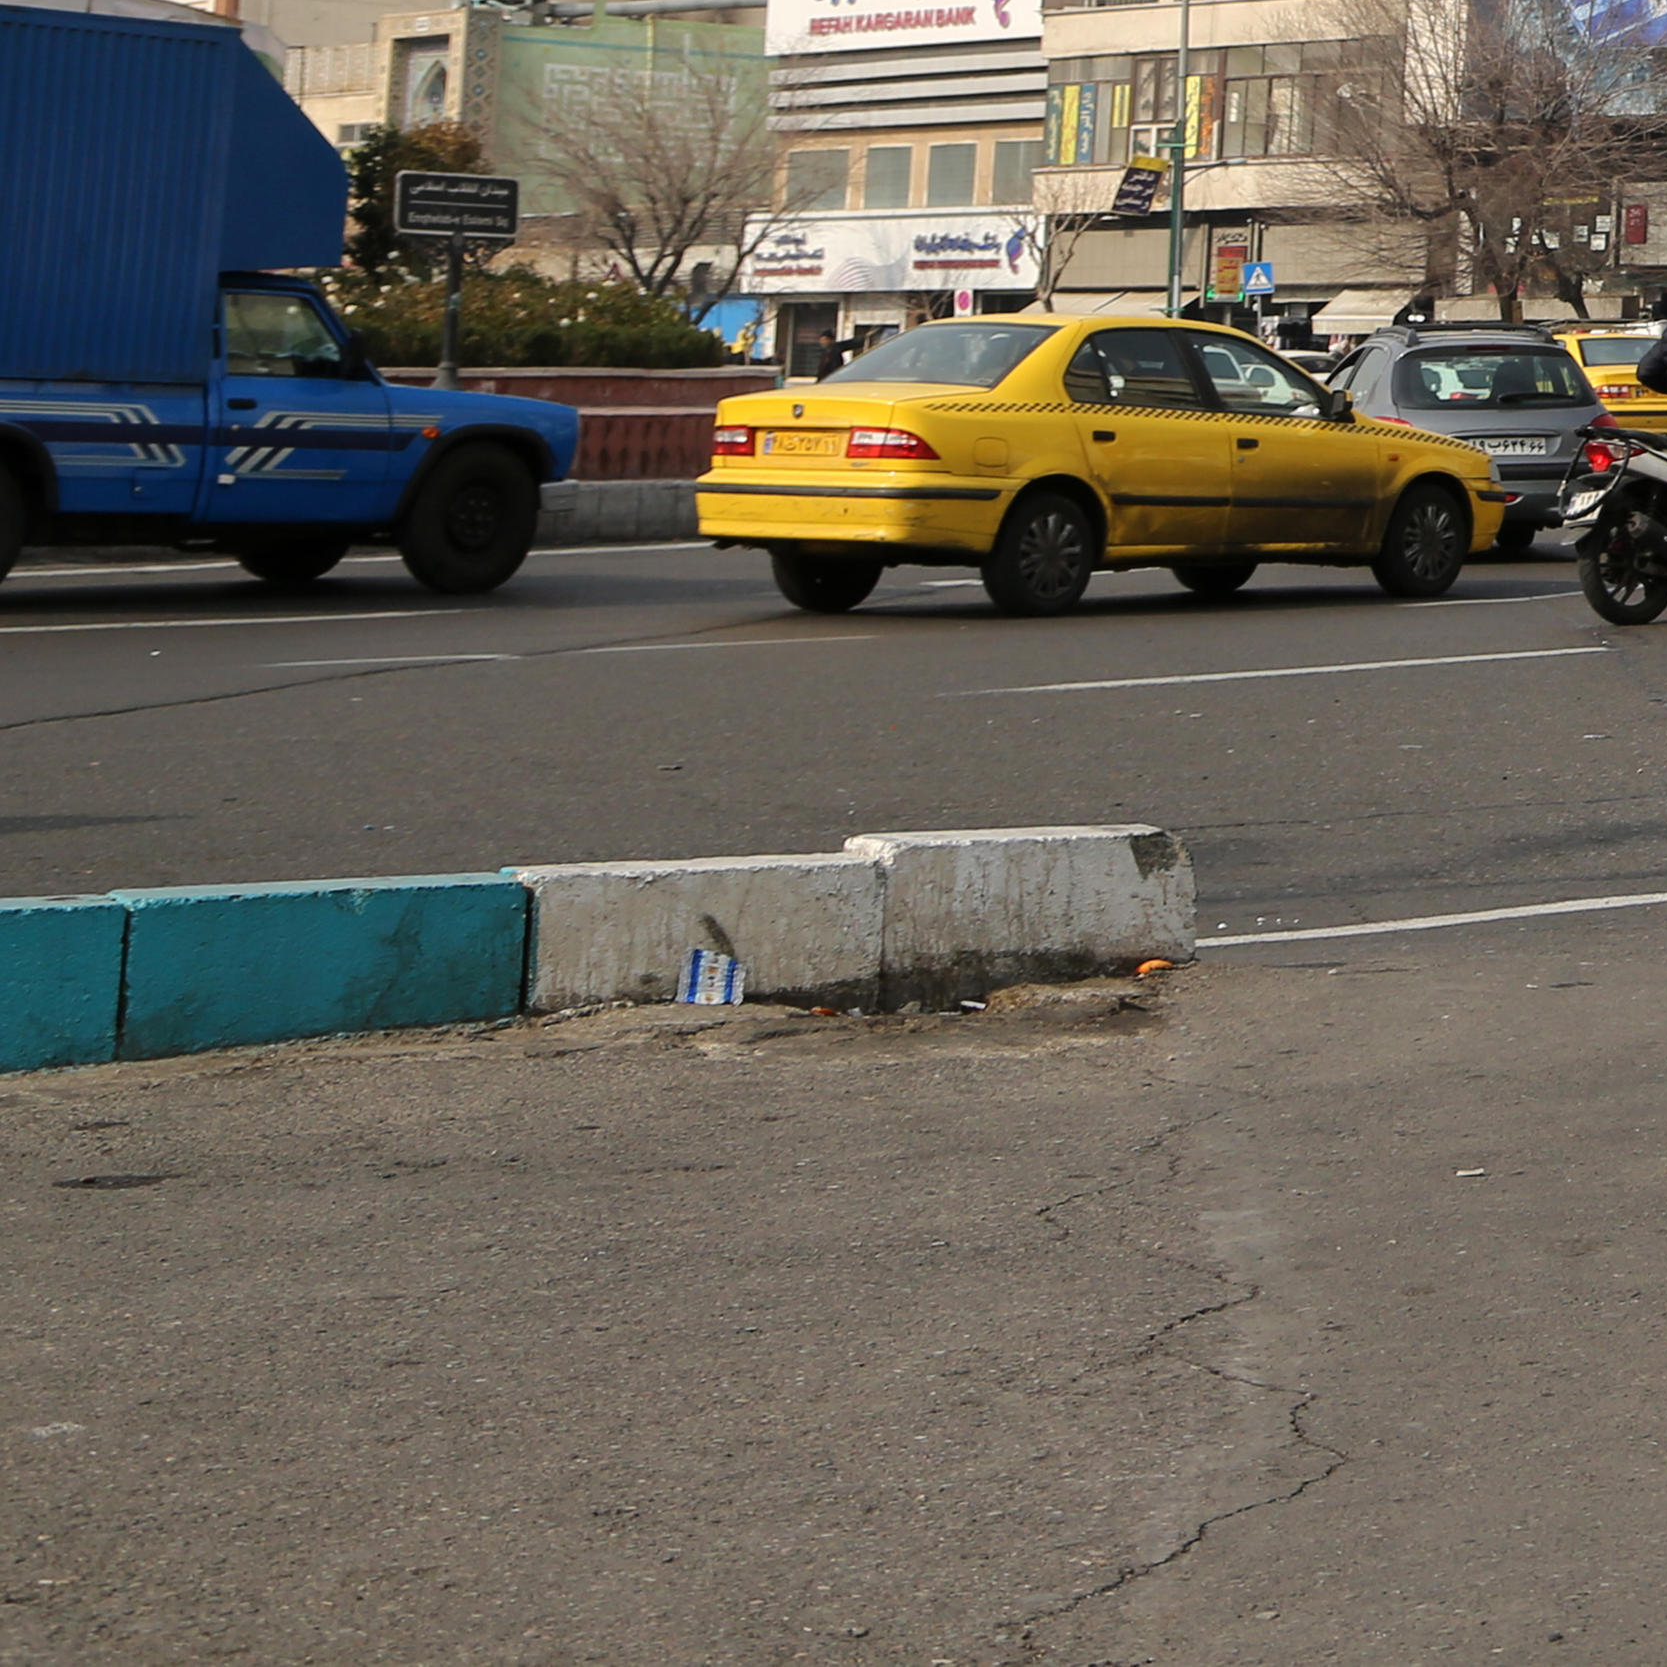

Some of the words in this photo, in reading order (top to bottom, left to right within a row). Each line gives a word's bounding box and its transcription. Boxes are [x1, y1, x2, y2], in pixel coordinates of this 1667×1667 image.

[810, 16, 855, 36] REFAH
[855, 9, 933, 33] KARGARAN
[935, 5, 976, 28] BANK
